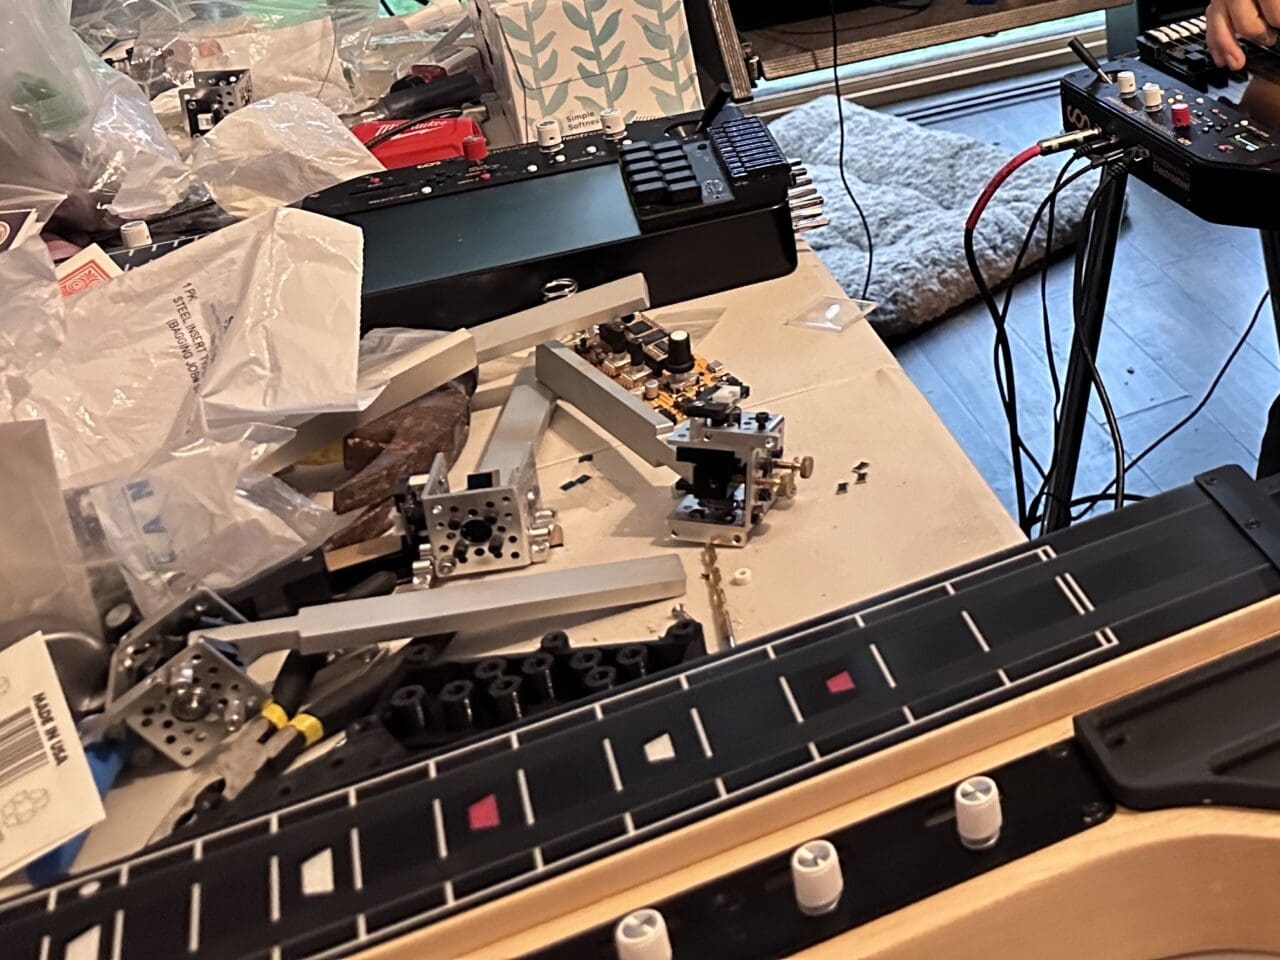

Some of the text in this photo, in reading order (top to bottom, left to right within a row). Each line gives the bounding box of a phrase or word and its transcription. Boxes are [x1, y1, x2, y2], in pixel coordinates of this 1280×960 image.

[566, 111, 595, 123] Simple
[568, 119, 600, 131] Softnes
[184, 288, 198, 302] PK
[173, 296, 193, 324] STEEL
[186, 324, 208, 353] INSERT
[166, 319, 194, 360] (BAGGING
[32, 691, 68, 768] MADE IN USA
